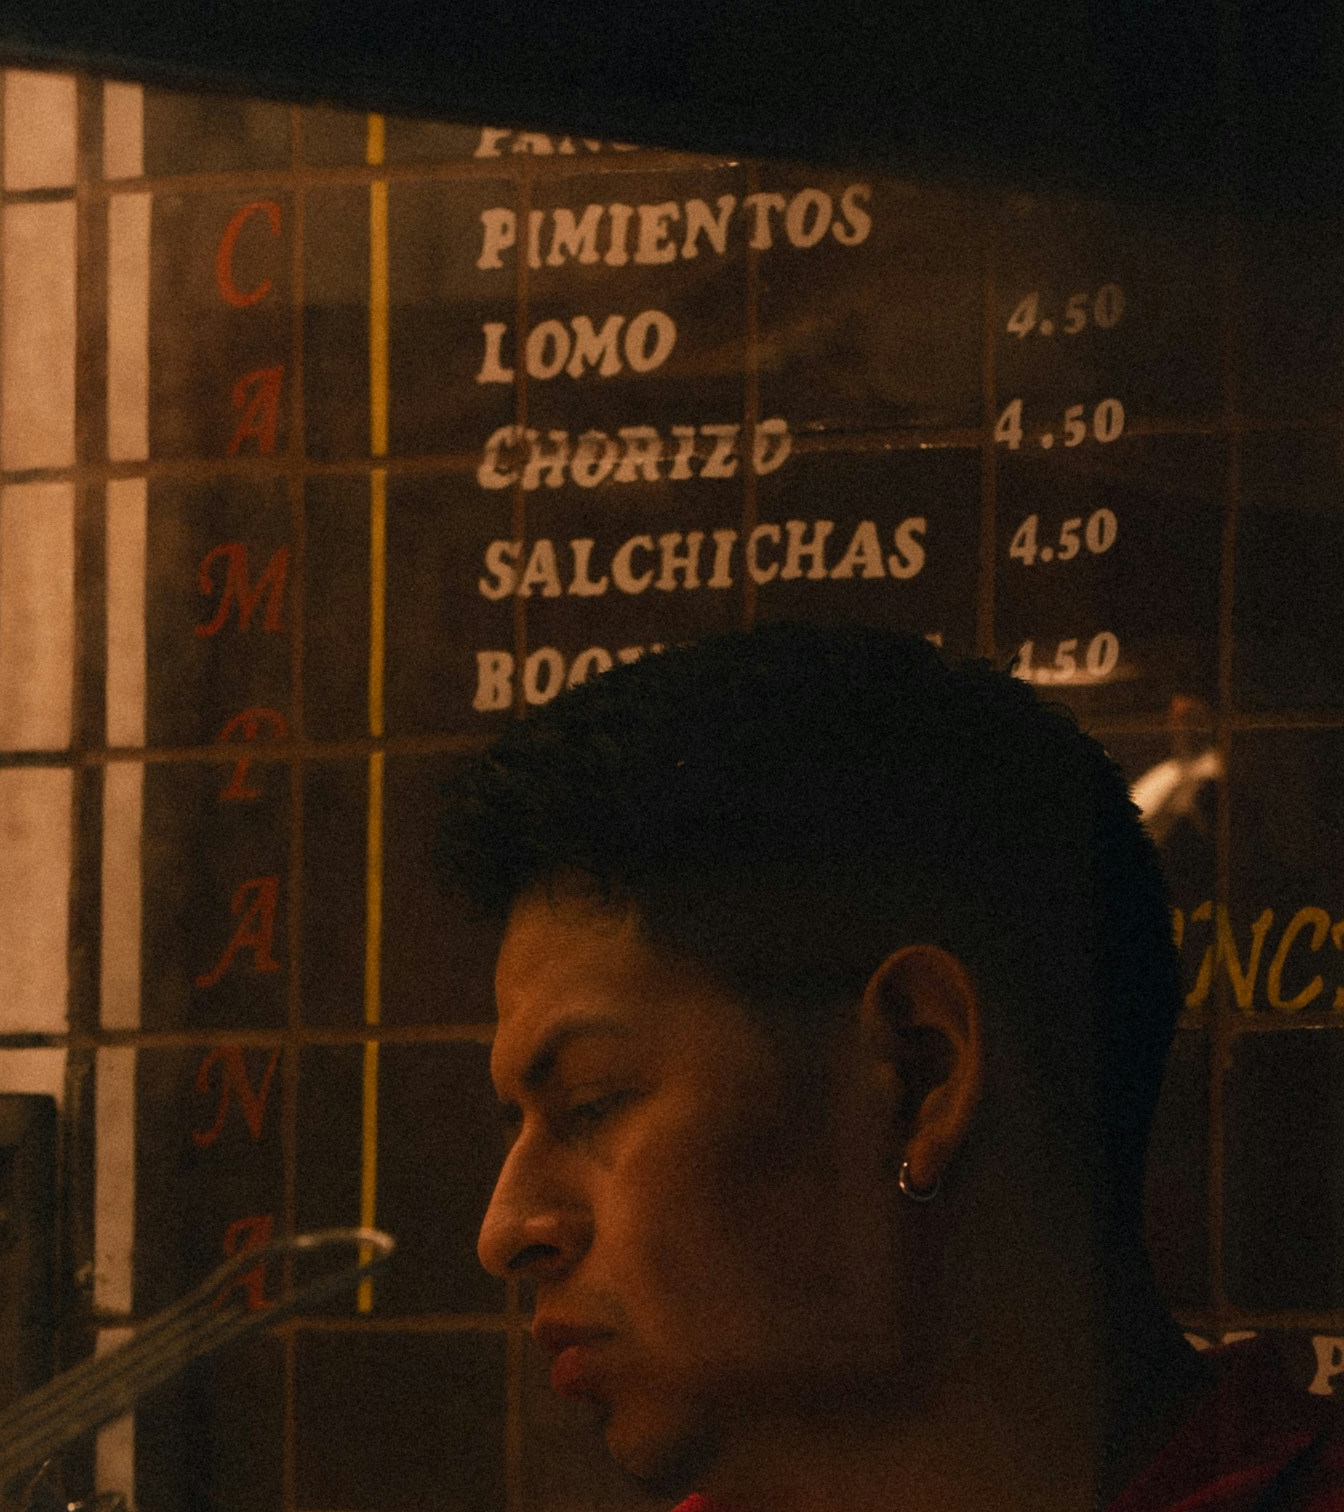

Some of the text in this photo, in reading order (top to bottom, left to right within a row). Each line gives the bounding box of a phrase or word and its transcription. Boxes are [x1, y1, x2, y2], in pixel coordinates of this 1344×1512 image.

[477, 184, 872, 270] PIMIENTOS
[476, 285, 1126, 384] LOMO 4.50
[476, 398, 1125, 490] CHORIZO 4.50
[478, 507, 1118, 601] SALCHICHAS 4.50
